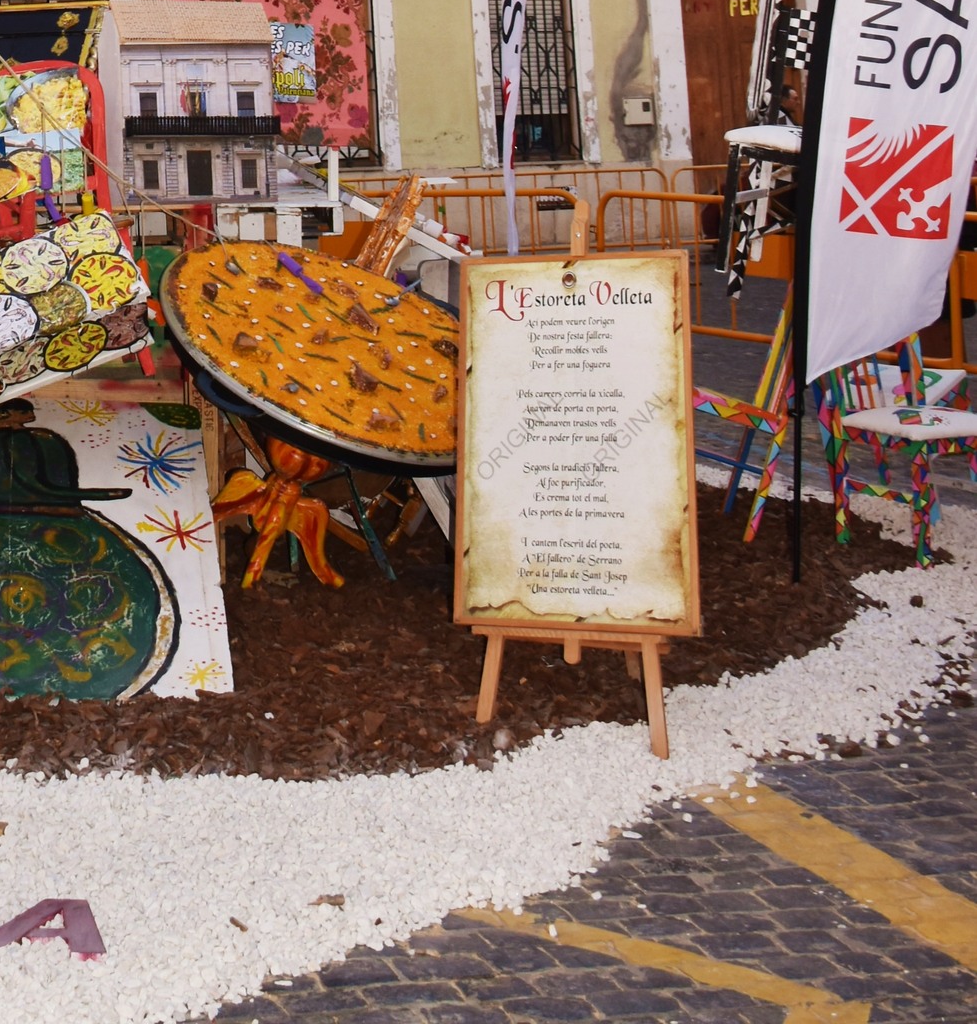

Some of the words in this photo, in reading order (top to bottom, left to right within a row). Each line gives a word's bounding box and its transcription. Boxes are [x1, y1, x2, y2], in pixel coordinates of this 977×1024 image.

[285, 40, 311, 57] PER
[485, 279, 587, 322] L'Estoreta
[589, 280, 653, 306] Velleta
[540, 317, 564, 329] podem
[527, 331, 541, 343] De
[542, 333, 565, 341] nostra
[566, 331, 584, 343] festa
[532, 345, 564, 358] Recollir
[565, 346, 590, 354] mobles
[591, 345, 608, 354] vells
[529, 360, 546, 373] Per
[553, 360, 565, 373] fer
[582, 361, 611, 373] foguera
[516, 389, 533, 401] Pels
[535, 390, 562, 398] carrers
[563, 389, 587, 397] corria
[589, 389, 596, 397] la
[522, 404, 552, 415] Anaven
[553, 403, 563, 412] de
[563, 405, 584, 416] porta
[586, 405, 595, 413] en
[525, 417, 571, 431] Demanaven
[572, 419, 598, 427] trastos
[600, 418, 617, 427] vells
[477, 390, 565, 480] ORIGINAL
[523, 432, 540, 443] Per
[548, 433, 570, 445] poder
[571, 432, 584, 445] fer
[601, 433, 618, 446] falla
[522, 462, 551, 475] Segons
[551, 462, 560, 472] la
[561, 462, 591, 472] tradició
[535, 477, 546, 488] Al
[546, 477, 560, 491] foc
[533, 492, 545, 502] Es
[571, 494, 582, 502] tot
[584, 493, 591, 502] el
[518, 508, 528, 519] A
[528, 507, 538, 517] les
[540, 509, 563, 519] portes
[564, 507, 573, 517] de
[574, 508, 583, 517] la
[584, 508, 625, 521] primavera
[521, 537, 528, 547] I
[531, 539, 558, 547] cantem
[585, 539, 598, 549] del
[521, 553, 532, 565] A
[576, 554, 586, 564] de
[587, 554, 623, 567] Serrano
[516, 567, 534, 578] Per
[542, 568, 550, 578] la
[551, 568, 568, 581] falla
[570, 569, 580, 579] de
[582, 569, 602, 582] Sant
[603, 570, 628, 584] Josep
[550, 586, 580, 595] estoreta
